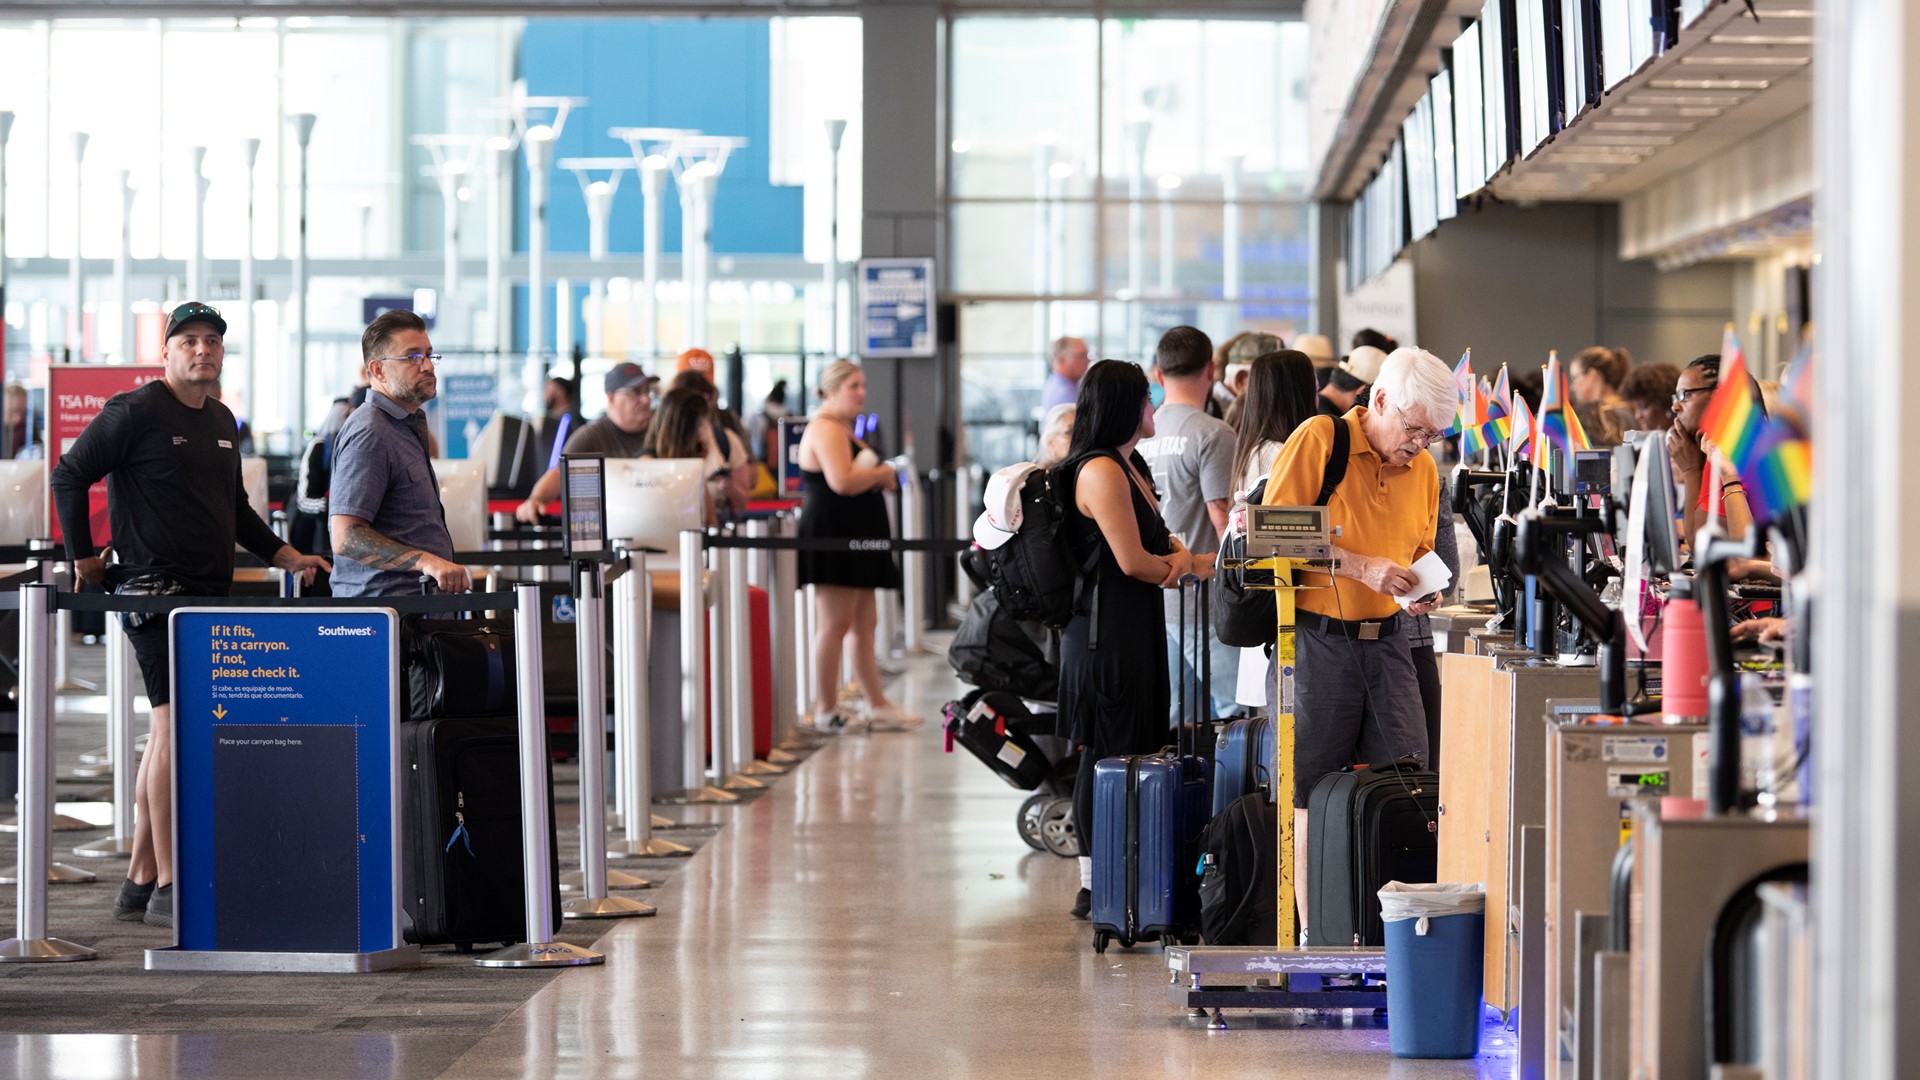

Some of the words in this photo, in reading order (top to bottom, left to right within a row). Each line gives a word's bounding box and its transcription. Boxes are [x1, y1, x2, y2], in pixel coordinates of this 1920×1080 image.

[58, 395, 82, 408] TSA
[1160, 436, 1187, 455] TEXAS
[849, 539, 890, 550] CLOSED
[211, 625, 220, 636] If
[222, 625, 231, 636] it
[233, 625, 255, 638] fits,
[318, 626, 371, 636] Southwest
[211, 639, 228, 650] it's
[231, 642, 238, 650] a
[241, 642, 289, 653] carryon.
[212, 653, 220, 664] If
[223, 654, 246, 666] not,
[212, 666, 249, 680] please
[251, 666, 286, 678] check
[288, 666, 300, 678] it.
[242, 685, 266, 693] equipaje
[274, 738, 286, 746] bag
